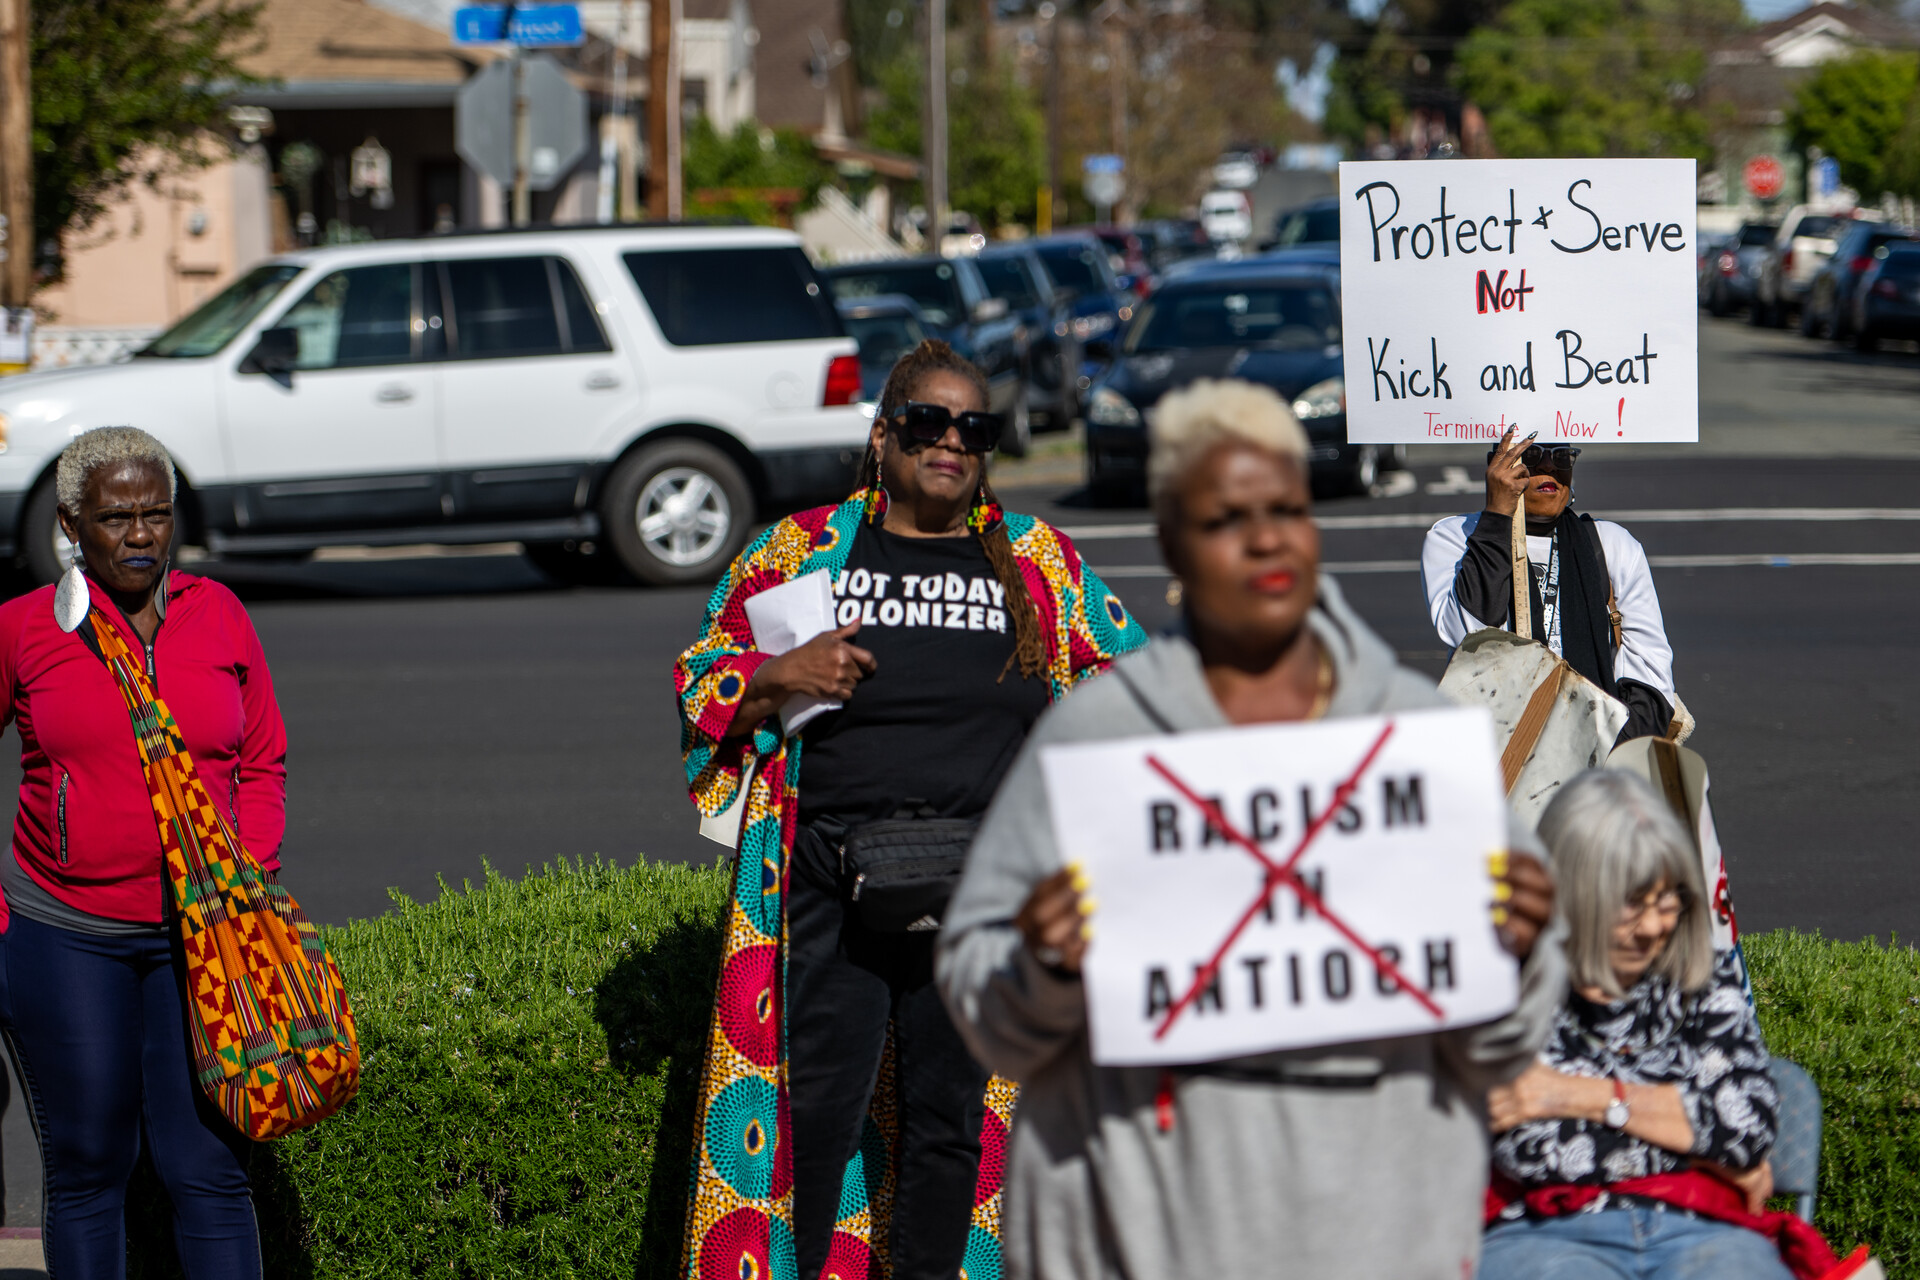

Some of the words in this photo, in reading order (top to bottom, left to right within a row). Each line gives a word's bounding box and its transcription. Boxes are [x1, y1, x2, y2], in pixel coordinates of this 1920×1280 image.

[1355, 181, 1522, 262] Protect
[1550, 179, 1686, 254] Serve
[1475, 268, 1534, 314] Not
[1367, 336, 1452, 402] Kick
[1479, 341, 1536, 392] and
[1555, 329, 1658, 389] Beat
[832, 599, 1007, 634] OLONIZER
[902, 572, 1004, 608] TODAY
[1148, 772, 1427, 853] RACISM
[1260, 867, 1327, 925] IN
[1143, 937, 1457, 1020] ANTIOCH
